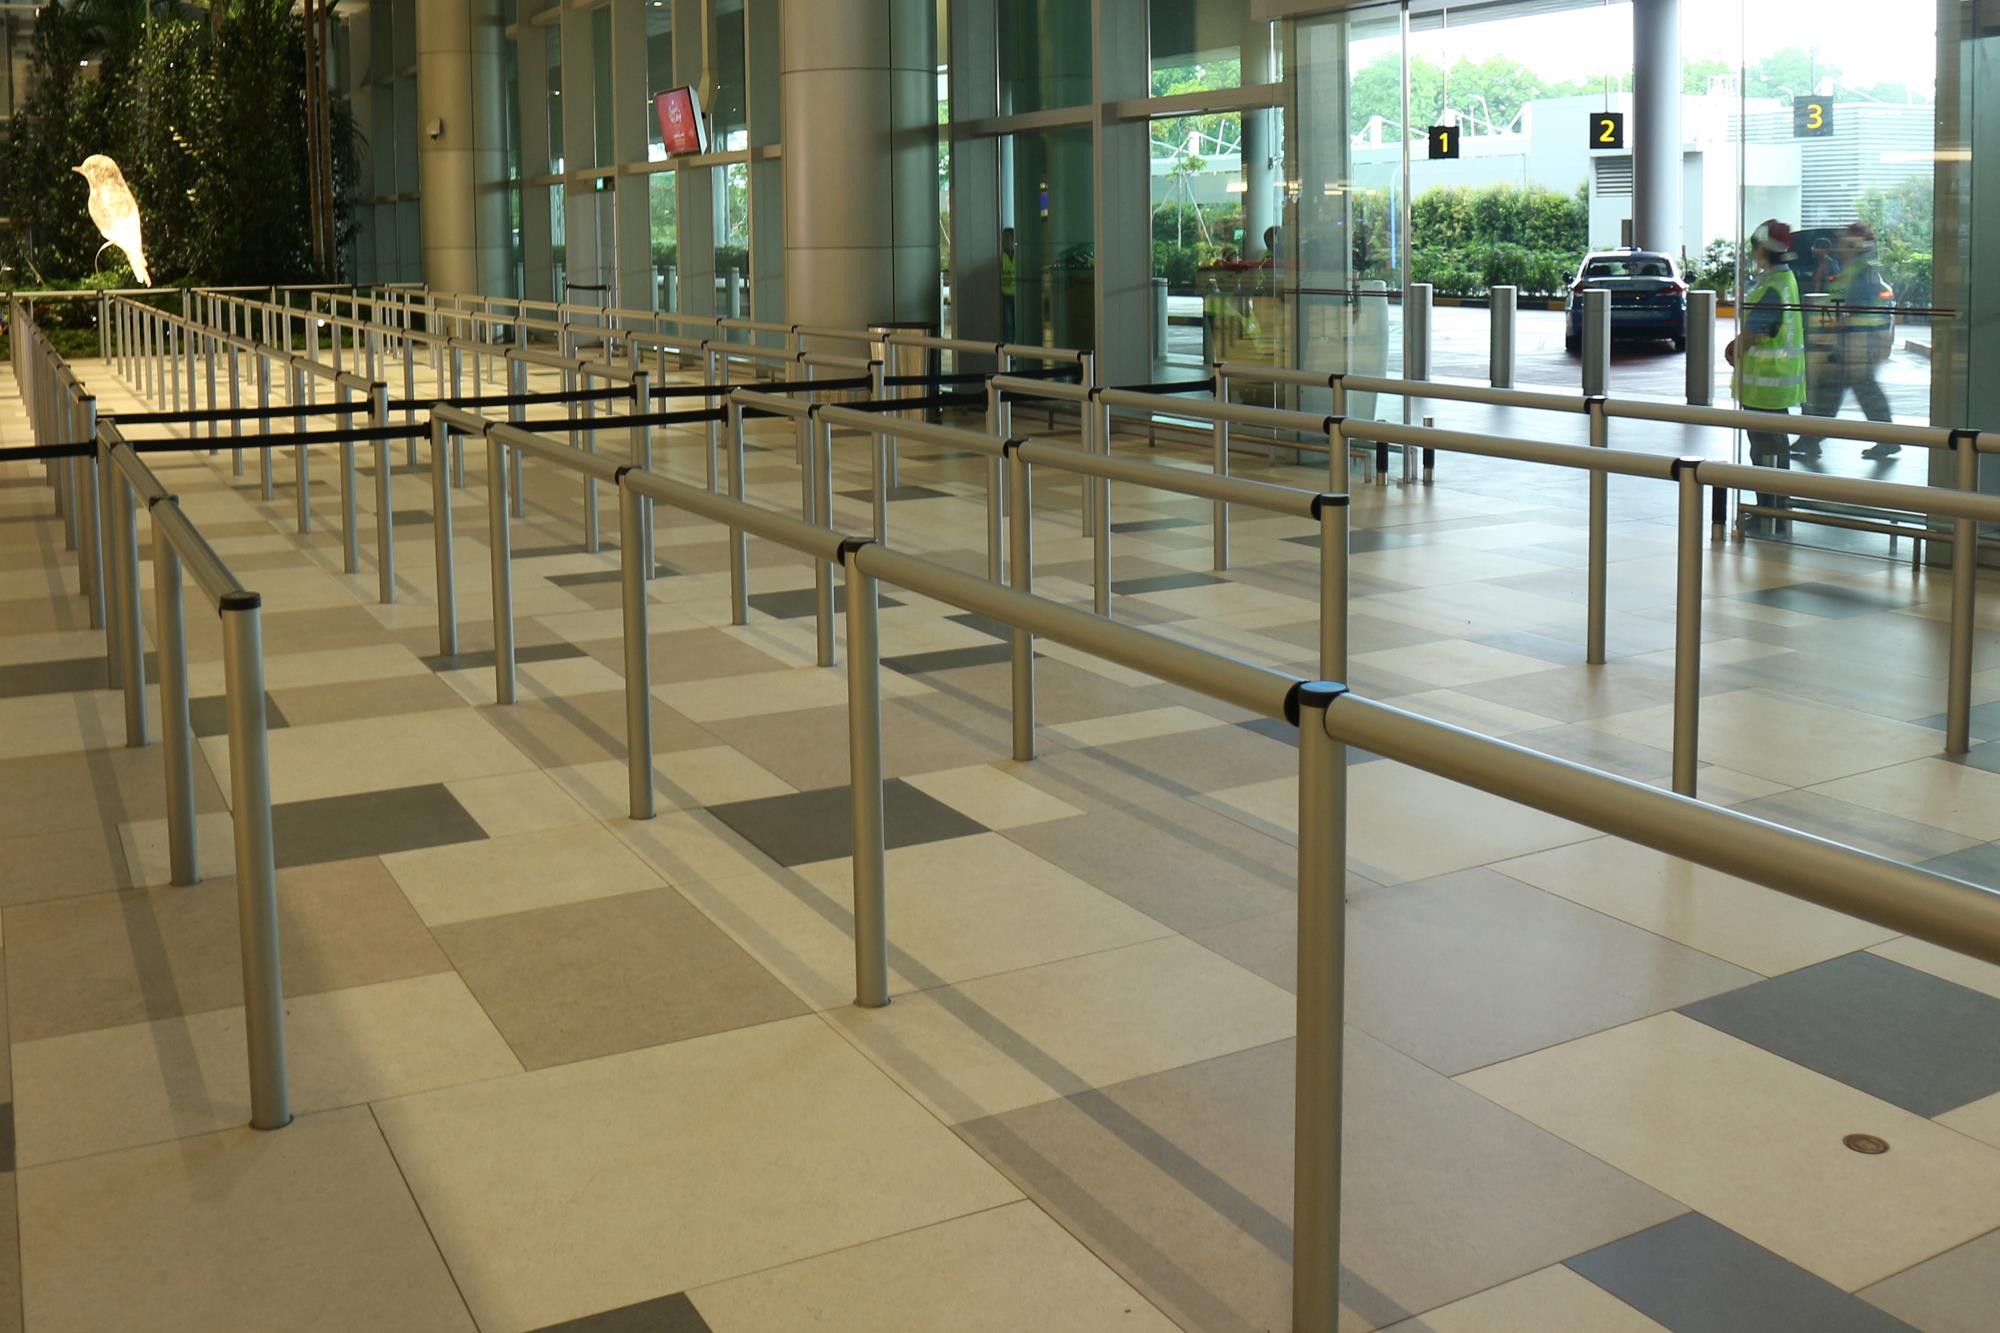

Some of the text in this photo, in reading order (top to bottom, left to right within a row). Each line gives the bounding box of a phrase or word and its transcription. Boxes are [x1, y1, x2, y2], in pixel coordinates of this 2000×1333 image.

[1807, 103, 1823, 129] 3
[1600, 119, 1615, 142] 2
[1440, 132, 1448, 153] 1
